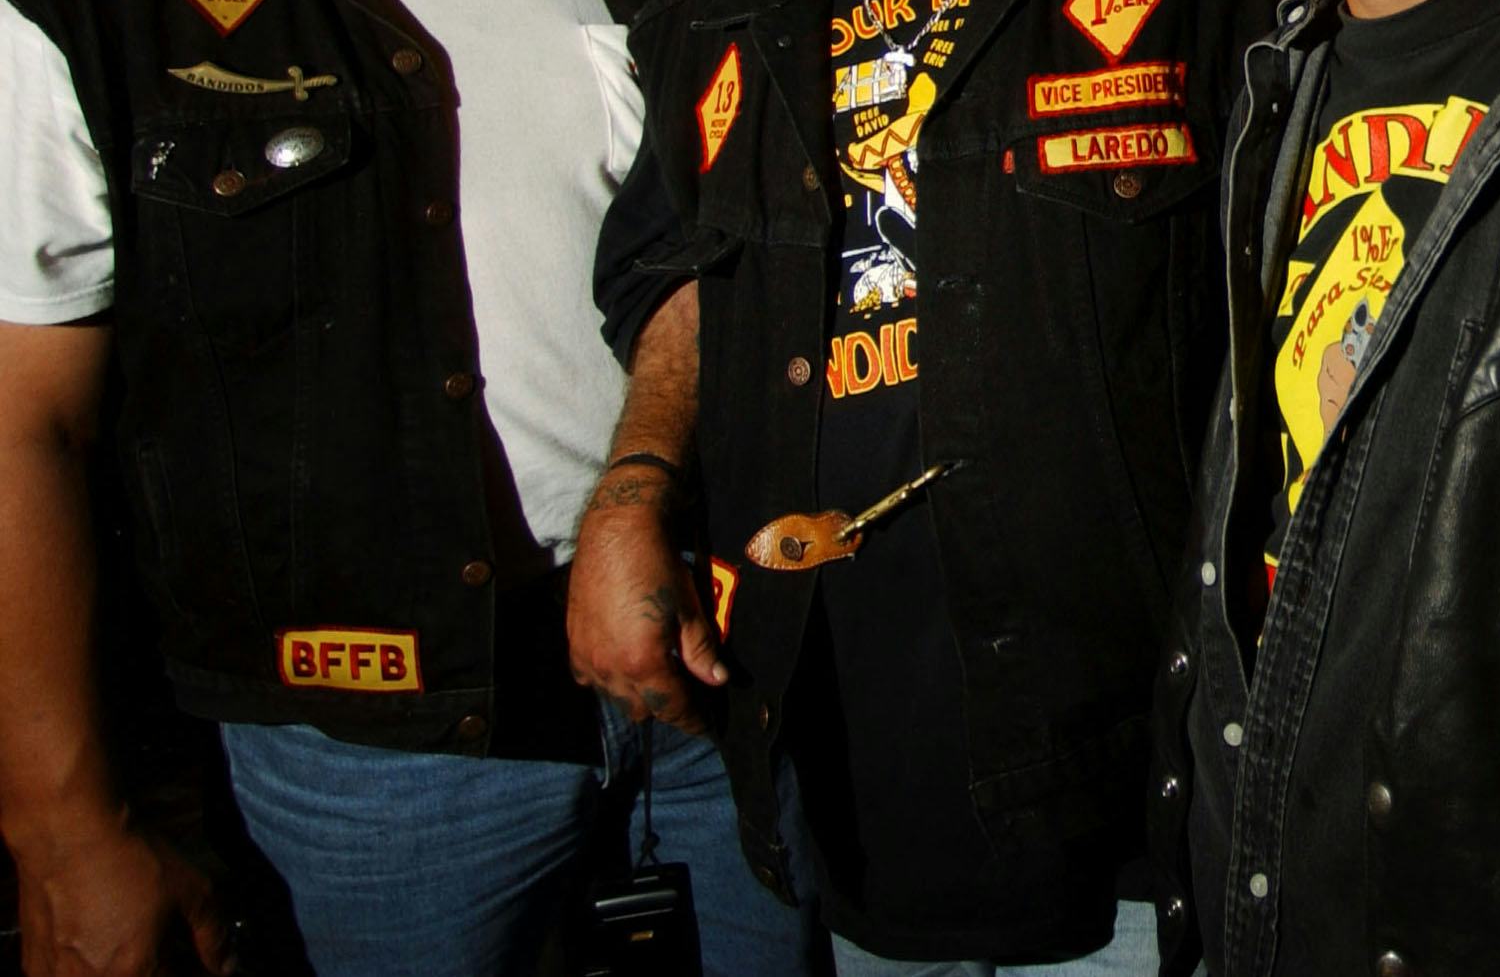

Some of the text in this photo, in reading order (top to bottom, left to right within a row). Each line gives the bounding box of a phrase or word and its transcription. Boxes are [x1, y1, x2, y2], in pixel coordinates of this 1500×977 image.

[929, 37, 955, 56] FREE
[187, 72, 265, 92] BANDIDOS
[714, 80, 735, 114] 13
[1041, 71, 1174, 105] VICE PRESIDE
[853, 105, 879, 126] FREE
[856, 114, 889, 139] DAVID
[1071, 128, 1169, 163] LAREDO
[1293, 280, 1346, 371] Para
[291, 640, 407, 682] BFFB
